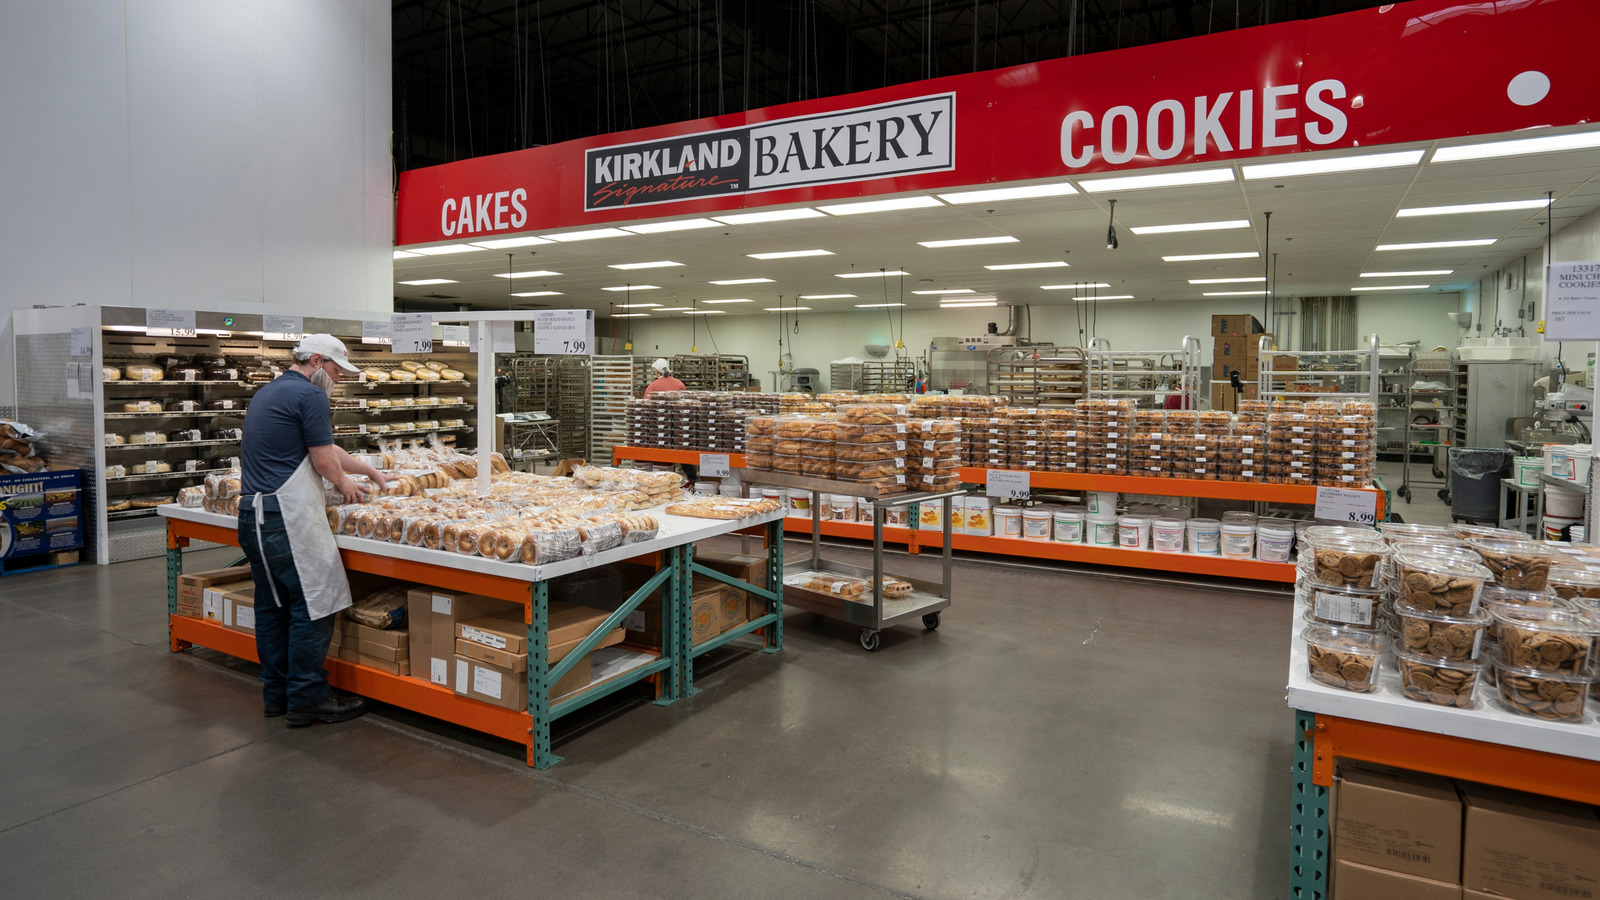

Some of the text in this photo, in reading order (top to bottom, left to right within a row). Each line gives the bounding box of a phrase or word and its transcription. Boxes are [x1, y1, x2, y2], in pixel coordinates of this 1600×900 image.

[1060, 79, 1348, 167] COOKIES
[754, 110, 943, 177] BAKERY
[595, 138, 742, 184] KIRKLAND
[593, 175, 739, 206] Signature
[441, 187, 528, 237] CAKES
[1585, 273, 1600, 281] CH
[1559, 281, 1600, 289] COOKIES
[170, 328, 195, 336] 15.99
[282, 332, 302, 340] 15.99
[414, 341, 432, 352] 7.99
[563, 341, 586, 353] 7.99
[1011, 489, 1029, 498] 9.99
[1348, 511, 1374, 522] 8.99
